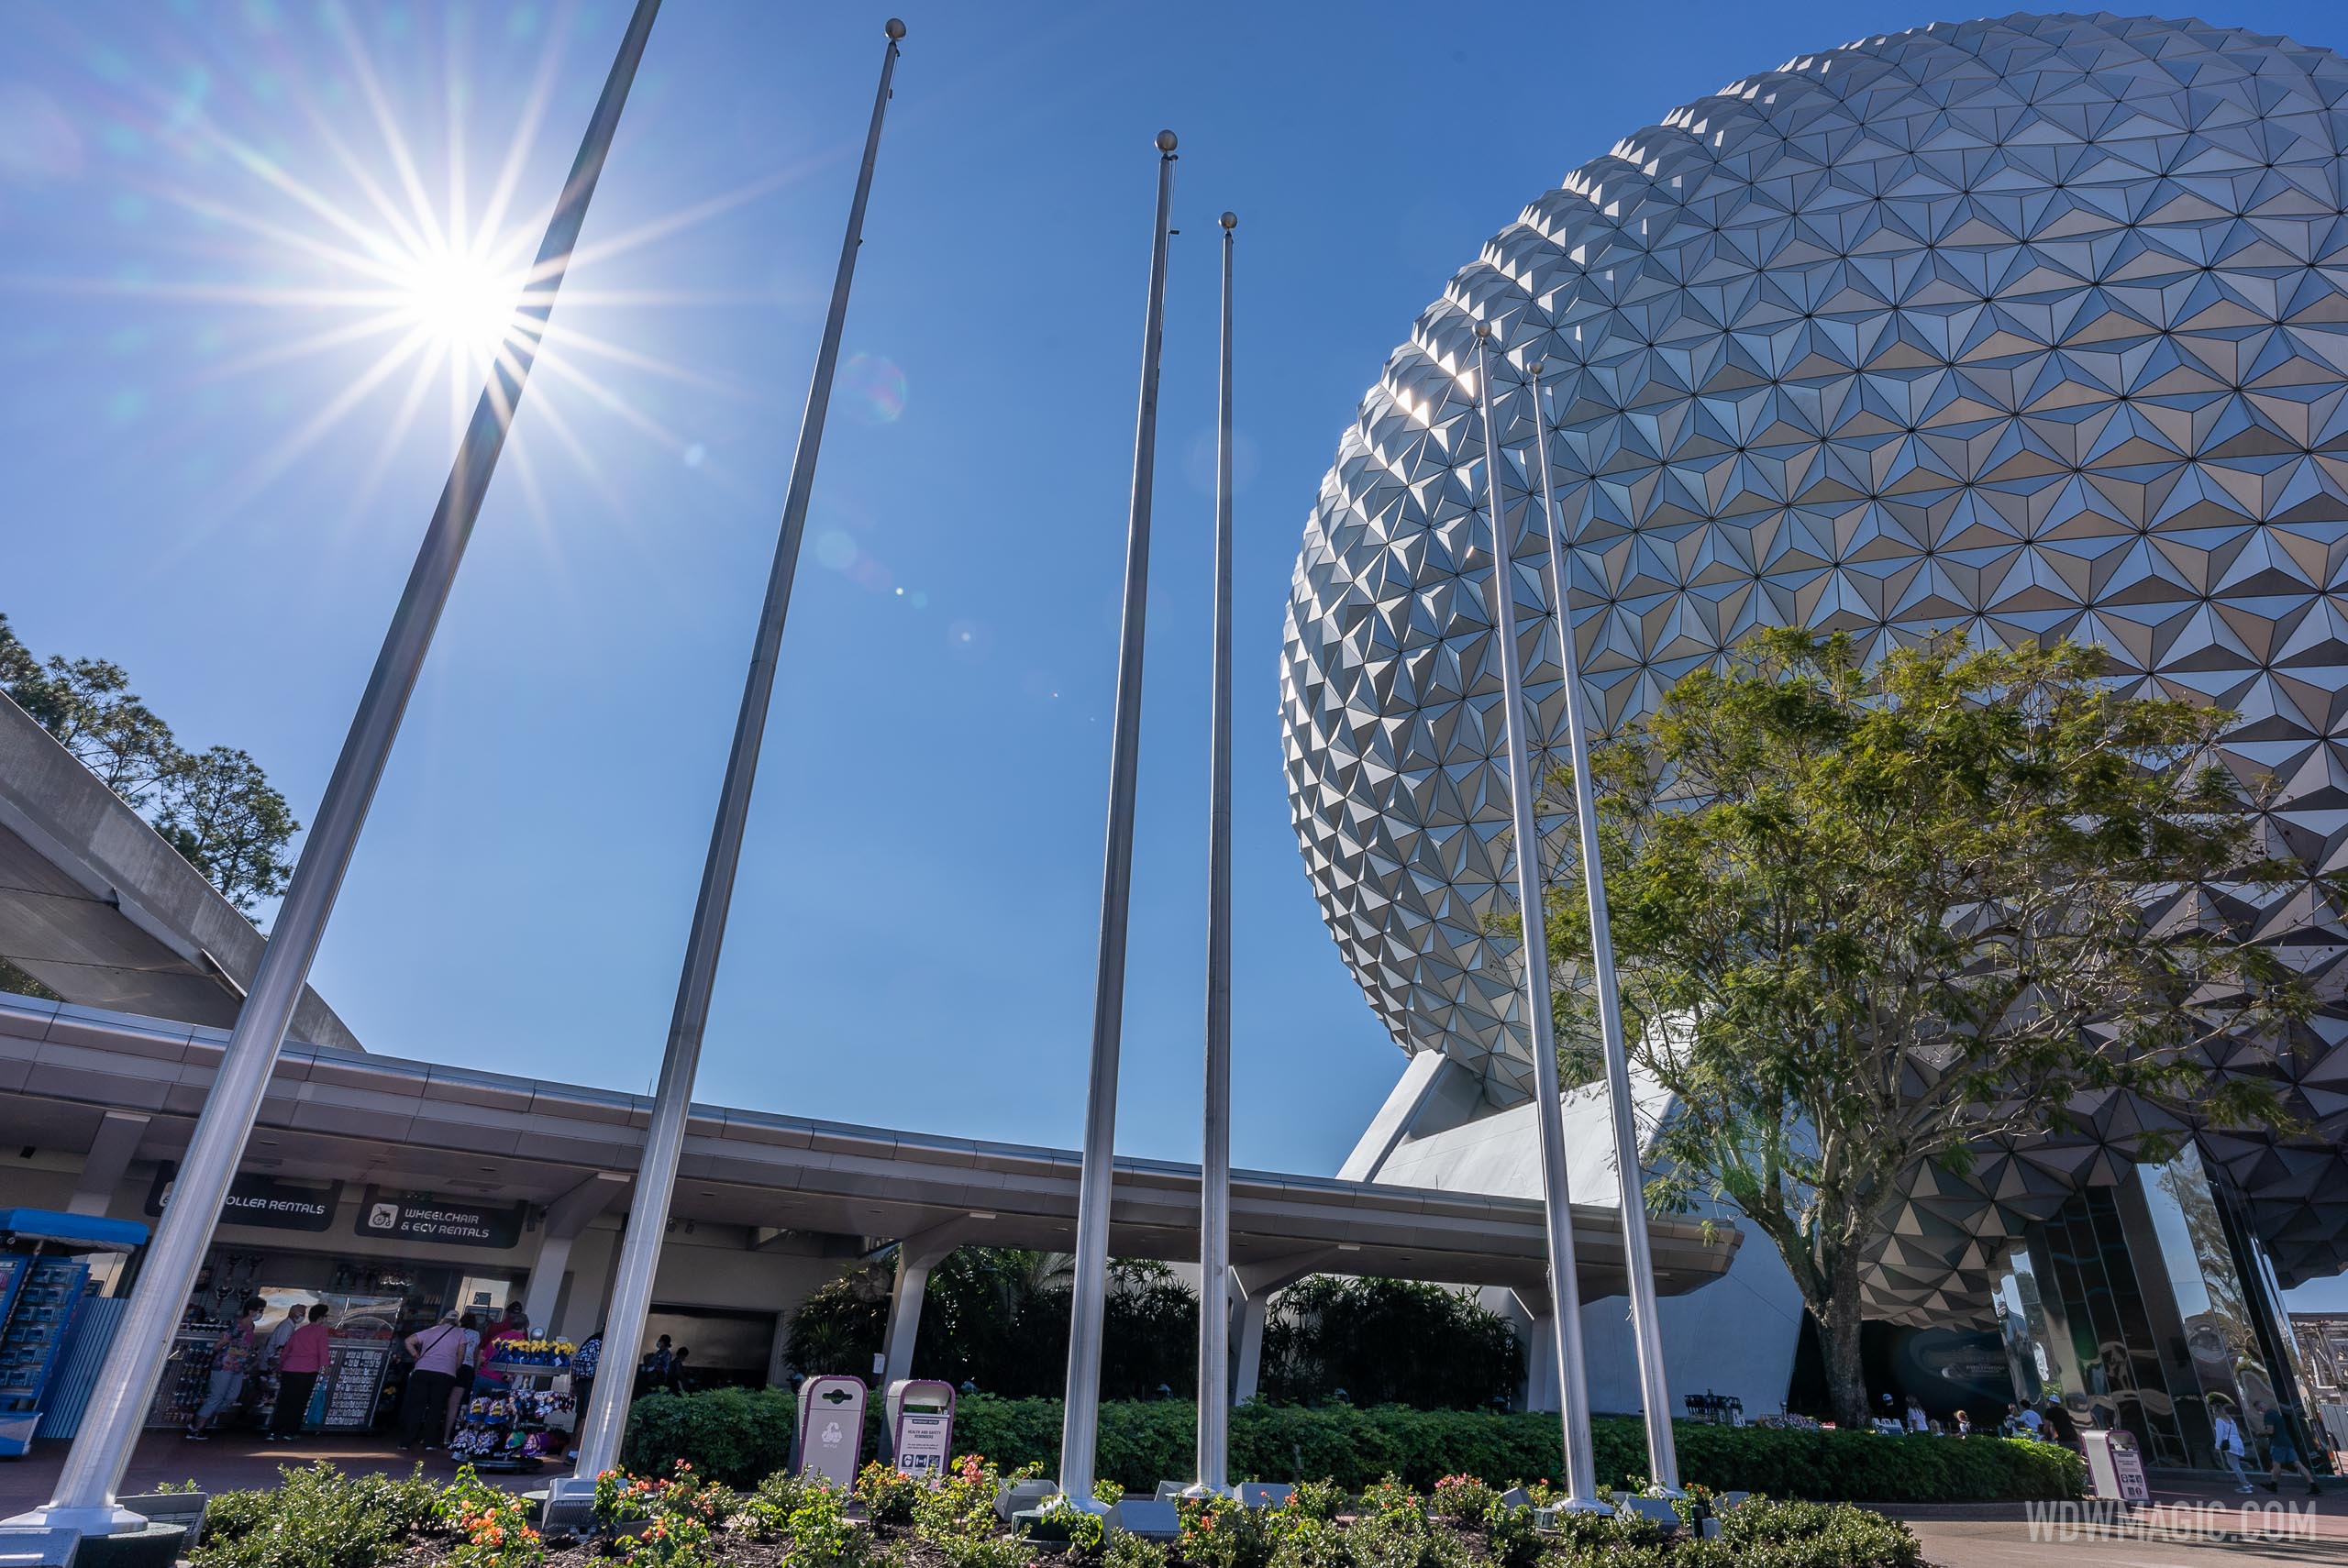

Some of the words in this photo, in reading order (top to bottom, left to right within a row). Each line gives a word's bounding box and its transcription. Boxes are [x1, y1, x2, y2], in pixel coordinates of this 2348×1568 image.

[226, 1196, 266, 1209] OLLER
[269, 1200, 326, 1215] RENTALS
[404, 1209, 480, 1224] WHEELCHAIR
[401, 1221, 409, 1231] &
[413, 1222, 437, 1233] ECV
[438, 1225, 490, 1238] RENTALS
